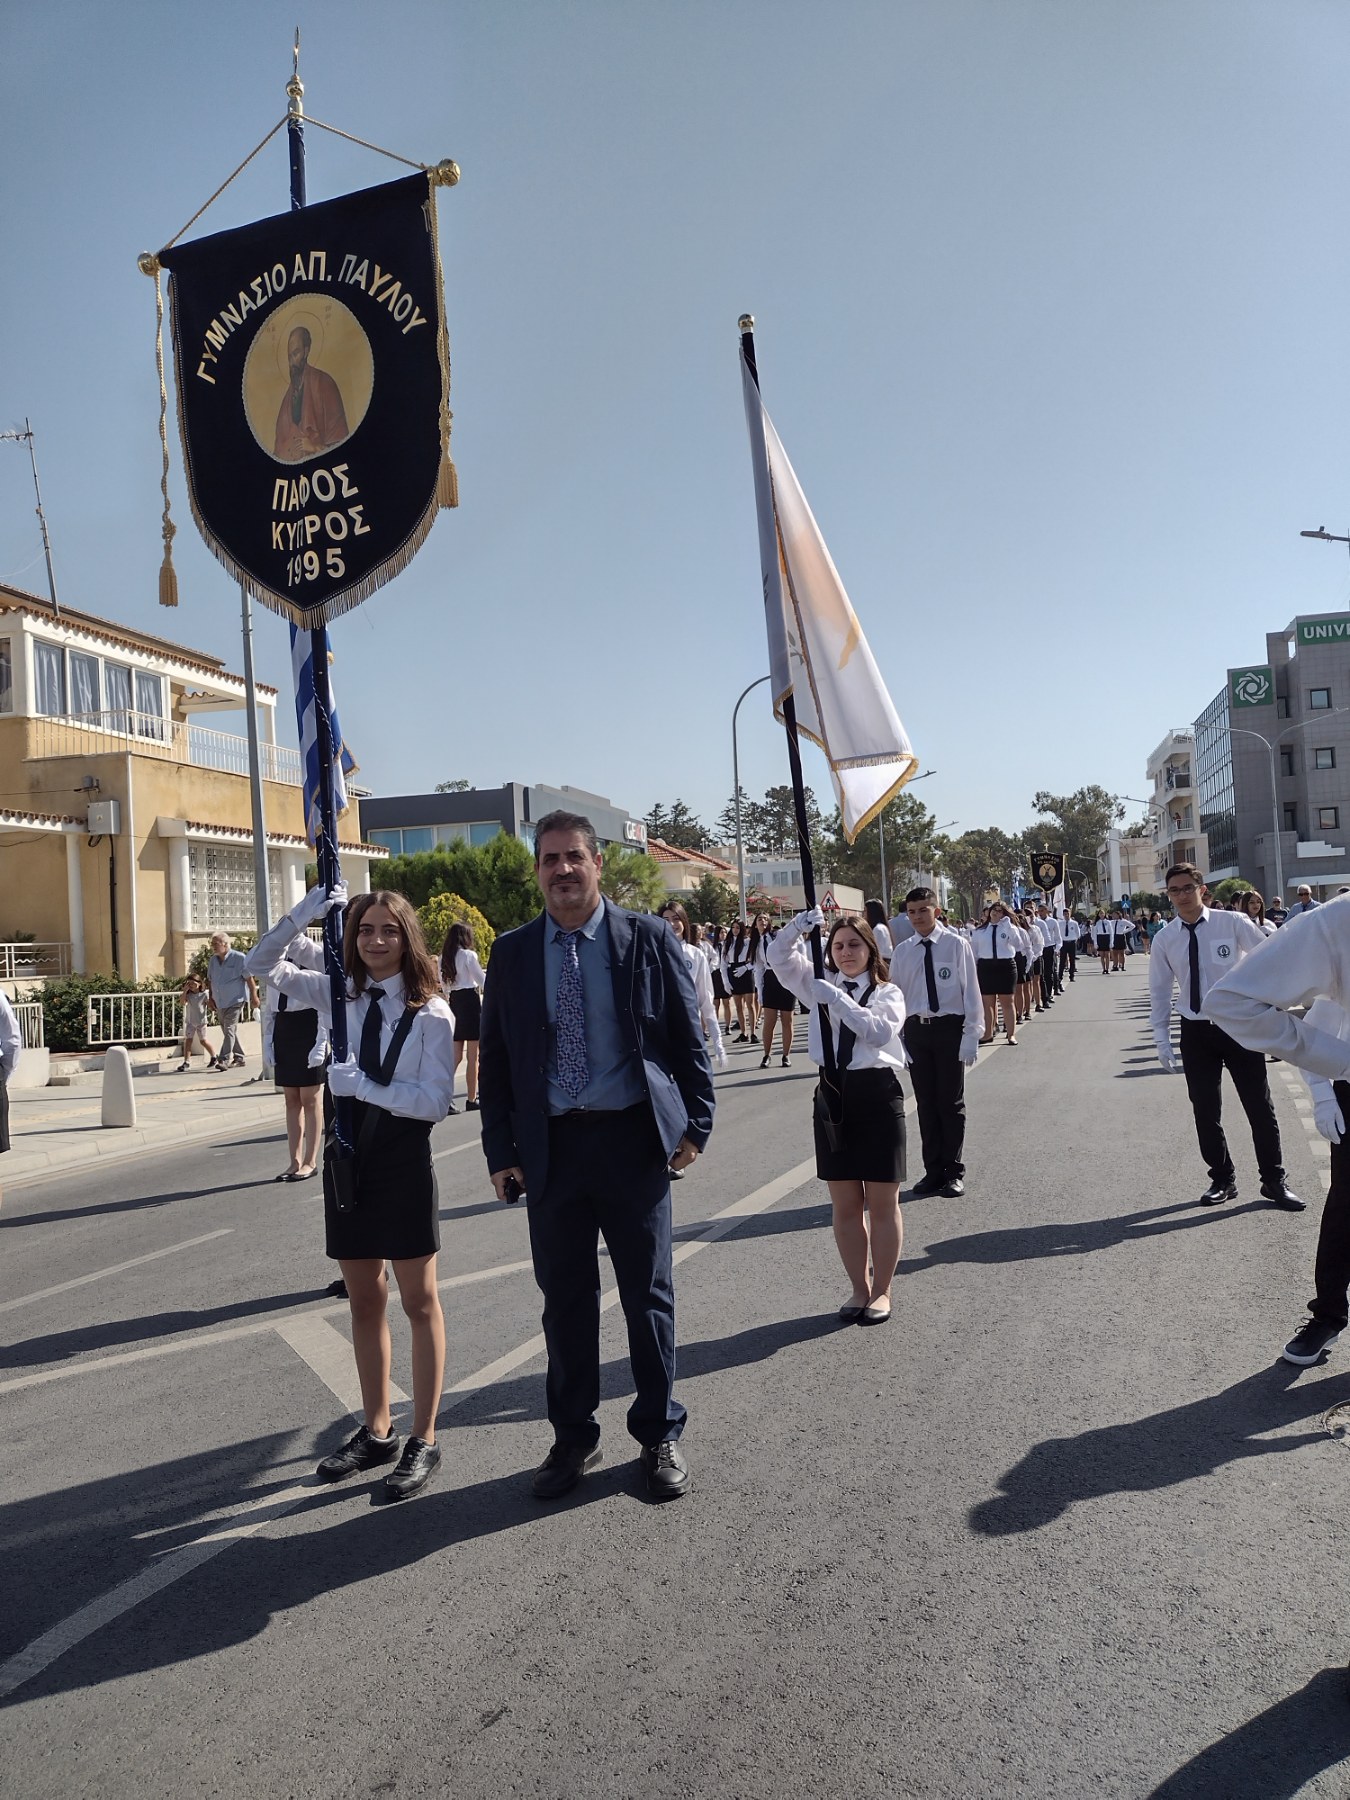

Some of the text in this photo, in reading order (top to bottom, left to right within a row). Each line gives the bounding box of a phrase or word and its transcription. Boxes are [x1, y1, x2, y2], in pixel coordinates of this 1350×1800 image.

[196, 251, 428, 385] ΓΥΜΝΑΣΙΟ ΑΠ. ΠΑΥΛΟΥ
[271, 462, 359, 512] ΠΑΦΟΣ
[271, 504, 371, 551] ΚΥΠΡΟΣ
[286, 547, 346, 587] 1995
